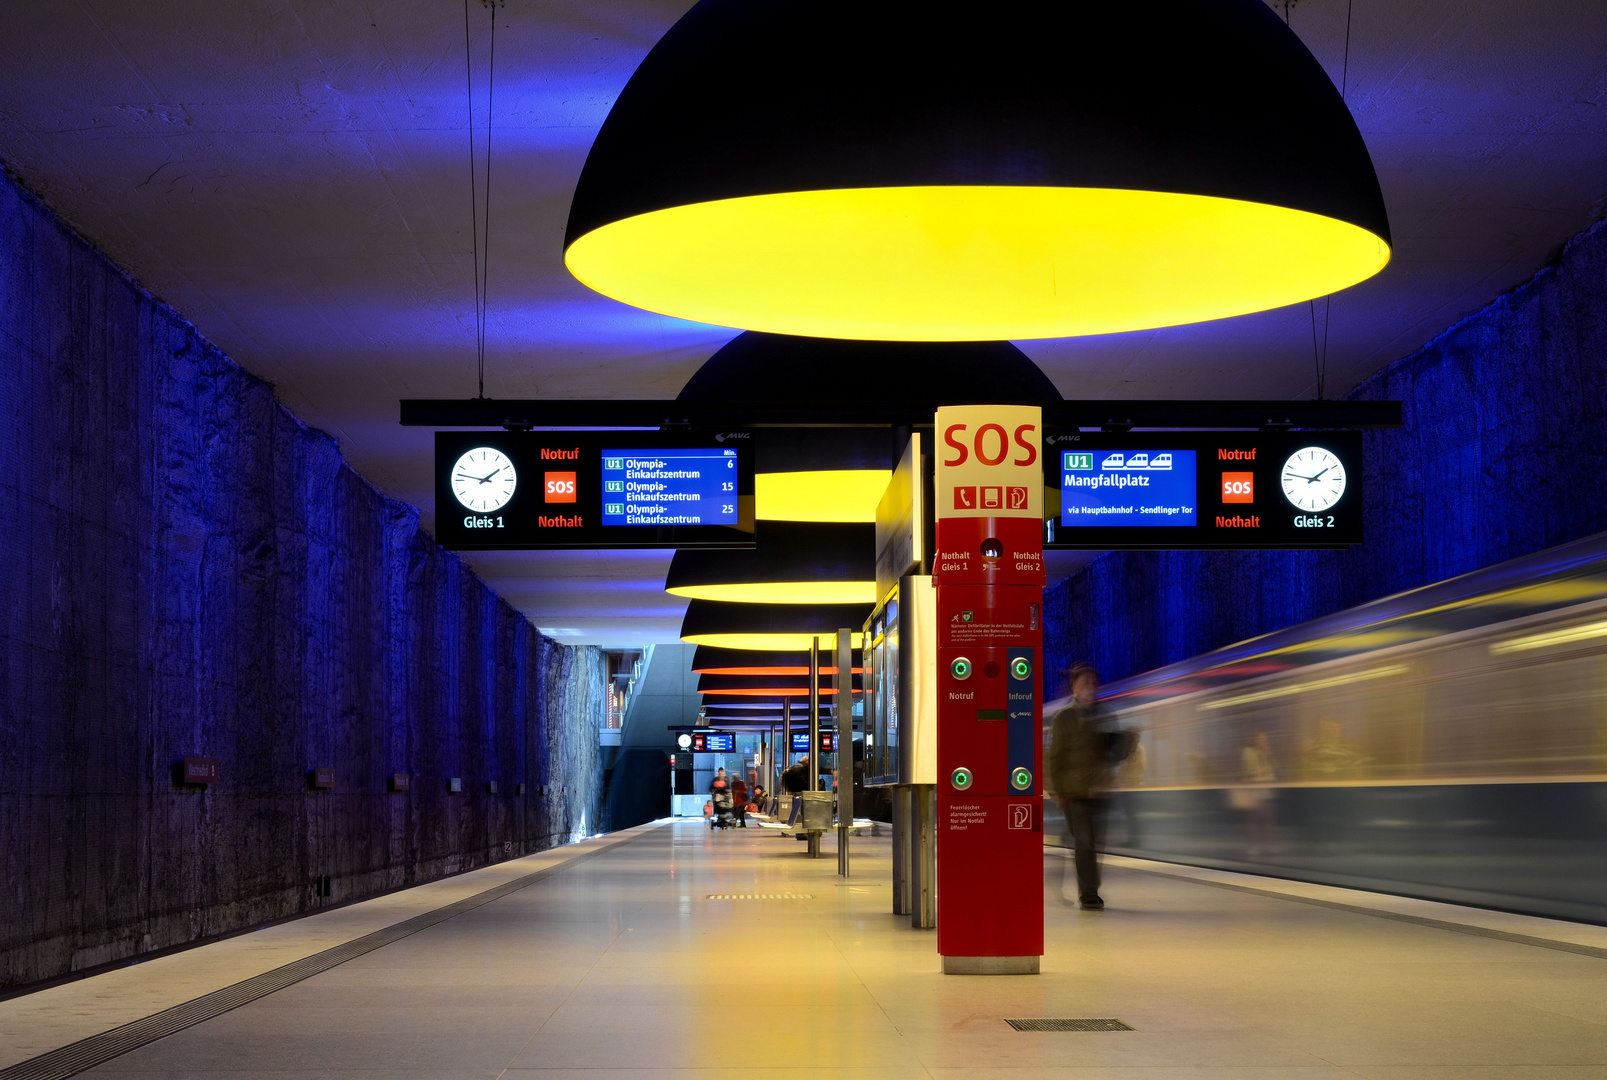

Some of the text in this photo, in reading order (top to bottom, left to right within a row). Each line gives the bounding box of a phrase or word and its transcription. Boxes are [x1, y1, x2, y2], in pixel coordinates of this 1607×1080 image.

[944, 423, 1037, 467] SOS
[540, 447, 580, 460] Notruf
[1218, 448, 1256, 460] Notruf
[608, 459, 734, 470] U1 Olympia- 6
[1068, 456, 1088, 468] U1
[626, 470, 700, 479] Einkaufszentrum
[547, 481, 574, 494] SOS
[626, 482, 668, 492] Olympia-
[722, 482, 734, 491] 15
[1064, 474, 1150, 489] Mangfallplatz
[1224, 482, 1251, 494] SOS
[626, 492, 700, 501] Einkaufszentrum
[626, 504, 668, 515] Olympia-
[722, 505, 734, 514] 25
[1081, 506, 1133, 515] Hauptbahnhof
[1140, 506, 1180, 515] Sendlinger
[464, 516, 504, 528] Gleis 1
[538, 515, 583, 527] Nothalt
[627, 515, 700, 524] Einkaufszentrum
[1216, 516, 1260, 528] Nothalt
[1294, 516, 1334, 528] Gleis 2
[506, 843, 511, 851] 2
